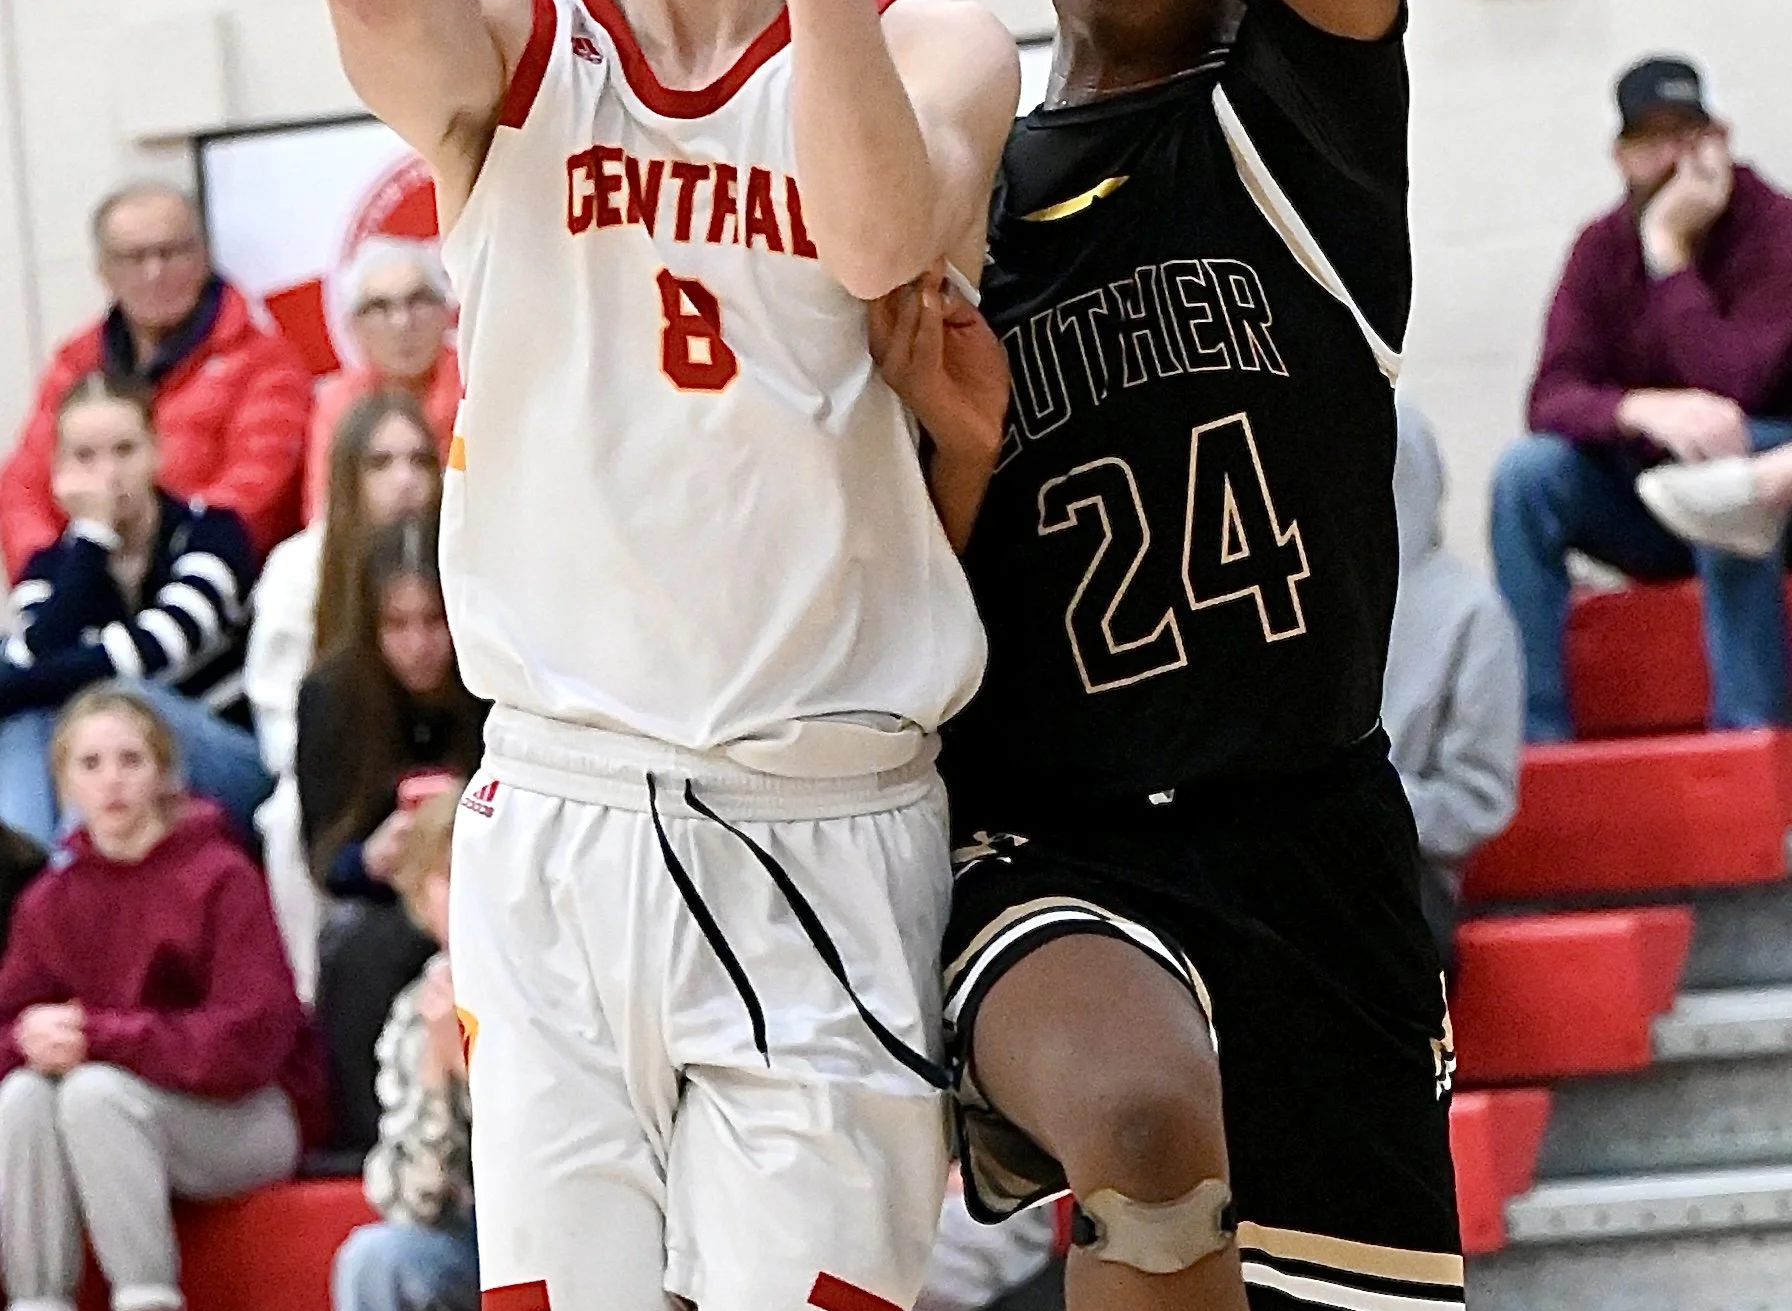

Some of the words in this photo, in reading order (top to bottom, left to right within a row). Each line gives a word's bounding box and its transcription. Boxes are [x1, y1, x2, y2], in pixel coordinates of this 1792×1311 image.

[566, 144, 819, 260] CENTRAL
[656, 267, 739, 393] 8
[992, 258, 1290, 475] UTHER
[1037, 410, 1312, 694] 24
